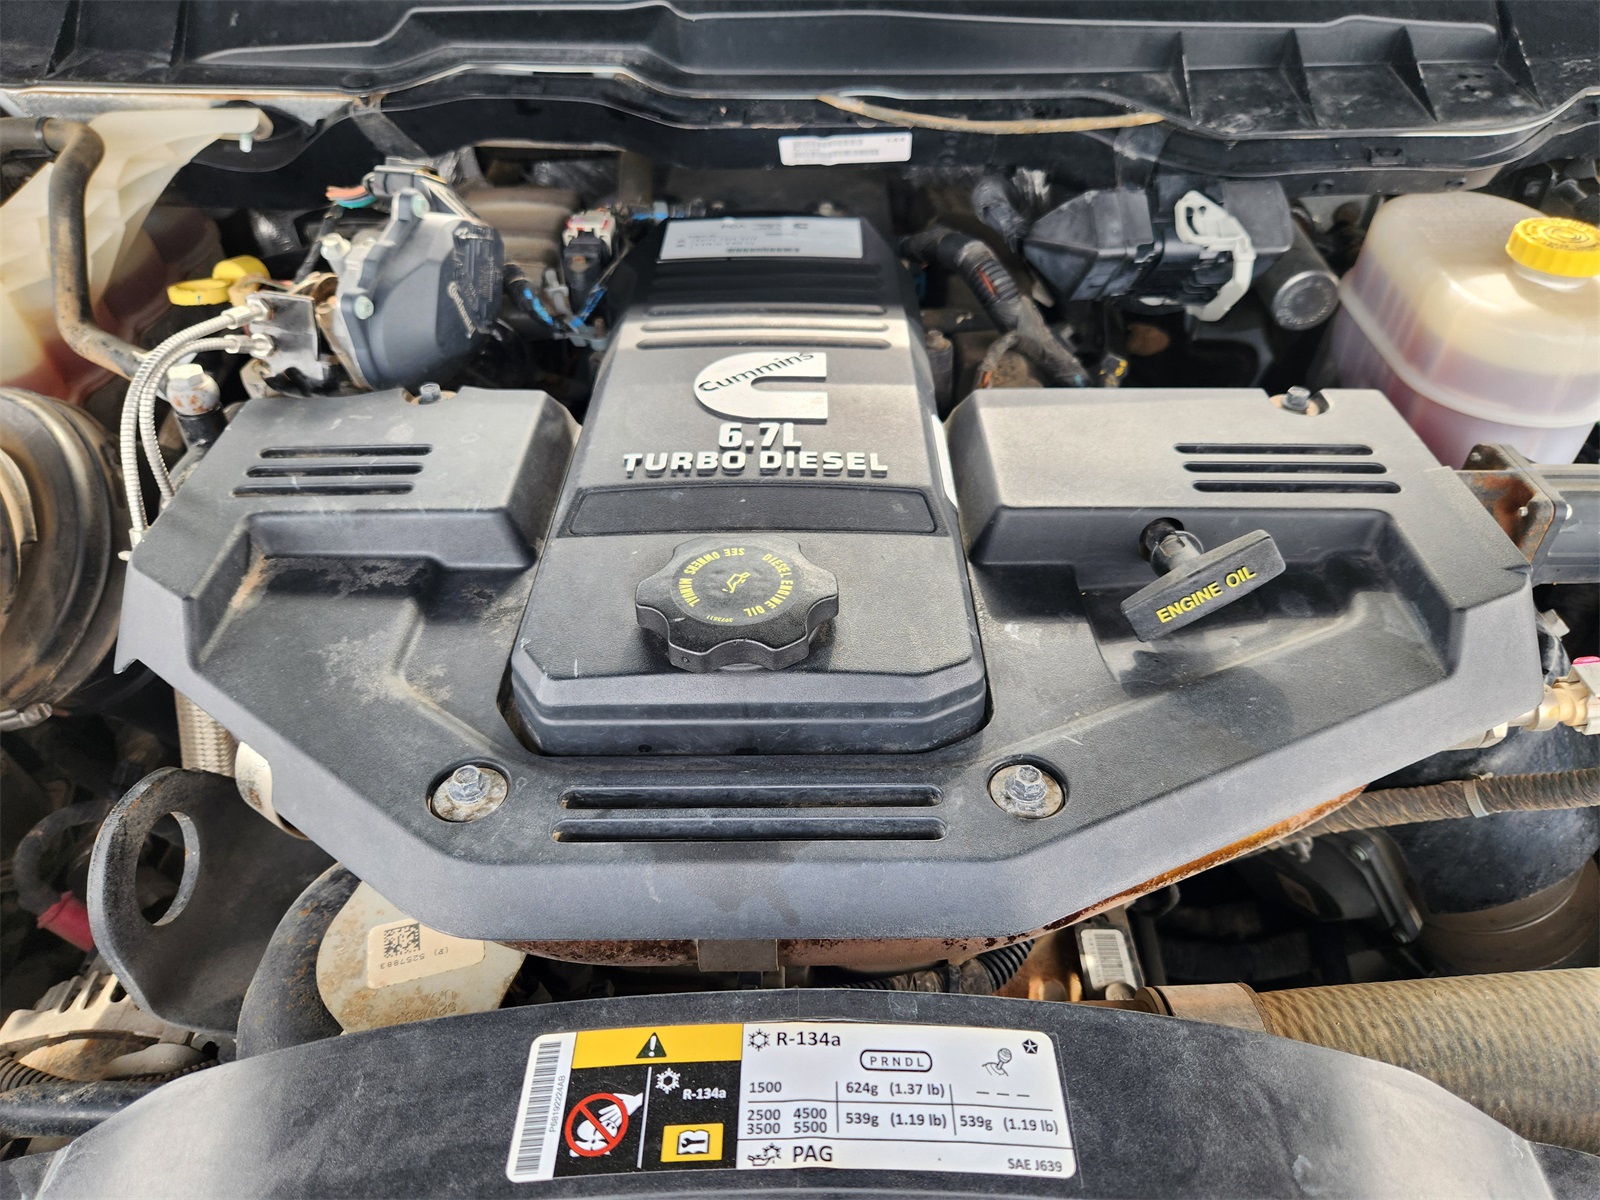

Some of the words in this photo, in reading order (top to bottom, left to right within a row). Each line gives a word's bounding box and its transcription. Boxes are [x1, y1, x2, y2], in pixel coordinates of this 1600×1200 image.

[698, 352, 815, 392] Cummins
[718, 422, 802, 451] 6.7L
[623, 451, 746, 477] TURBO
[759, 451, 888, 477] DIESEL
[723, 547, 745, 557] SEE
[683, 551, 721, 575] OWNERS
[762, 553, 793, 578] DIESEL
[678, 577, 701, 608] MANUAL
[764, 579, 794, 610] ENGINE
[1156, 581, 1223, 623] ENGINE
[1225, 566, 1257, 588] OIL
[743, 607, 765, 618] OIL
[380, 953, 425, 970] 5257883
[777, 1031, 841, 1047] R-134a
[682, 1088, 727, 1100] R-134a
[749, 1081, 782, 1093] 1500
[846, 1082, 878, 1096] 624g
[889, 1082, 923, 1097] (1.37
[927, 1083, 945, 1098] lb)
[549, 1075, 566, 1133] P68192224AB
[747, 1109, 781, 1121] 2500
[793, 1107, 827, 1120] 4500
[845, 1112, 879, 1127] 539g
[890, 1112, 925, 1128] (1.19
[929, 1113, 947, 1129] lb)
[747, 1122, 781, 1135] 3500
[793, 1121, 828, 1133] 5500
[959, 1115, 993, 1131] 539g
[1003, 1116, 1037, 1132] (1.19
[1041, 1119, 1059, 1135] lb)
[793, 1145, 833, 1162] PAG
[1007, 1158, 1032, 1170] SAE
[1035, 1160, 1063, 1173] J639
